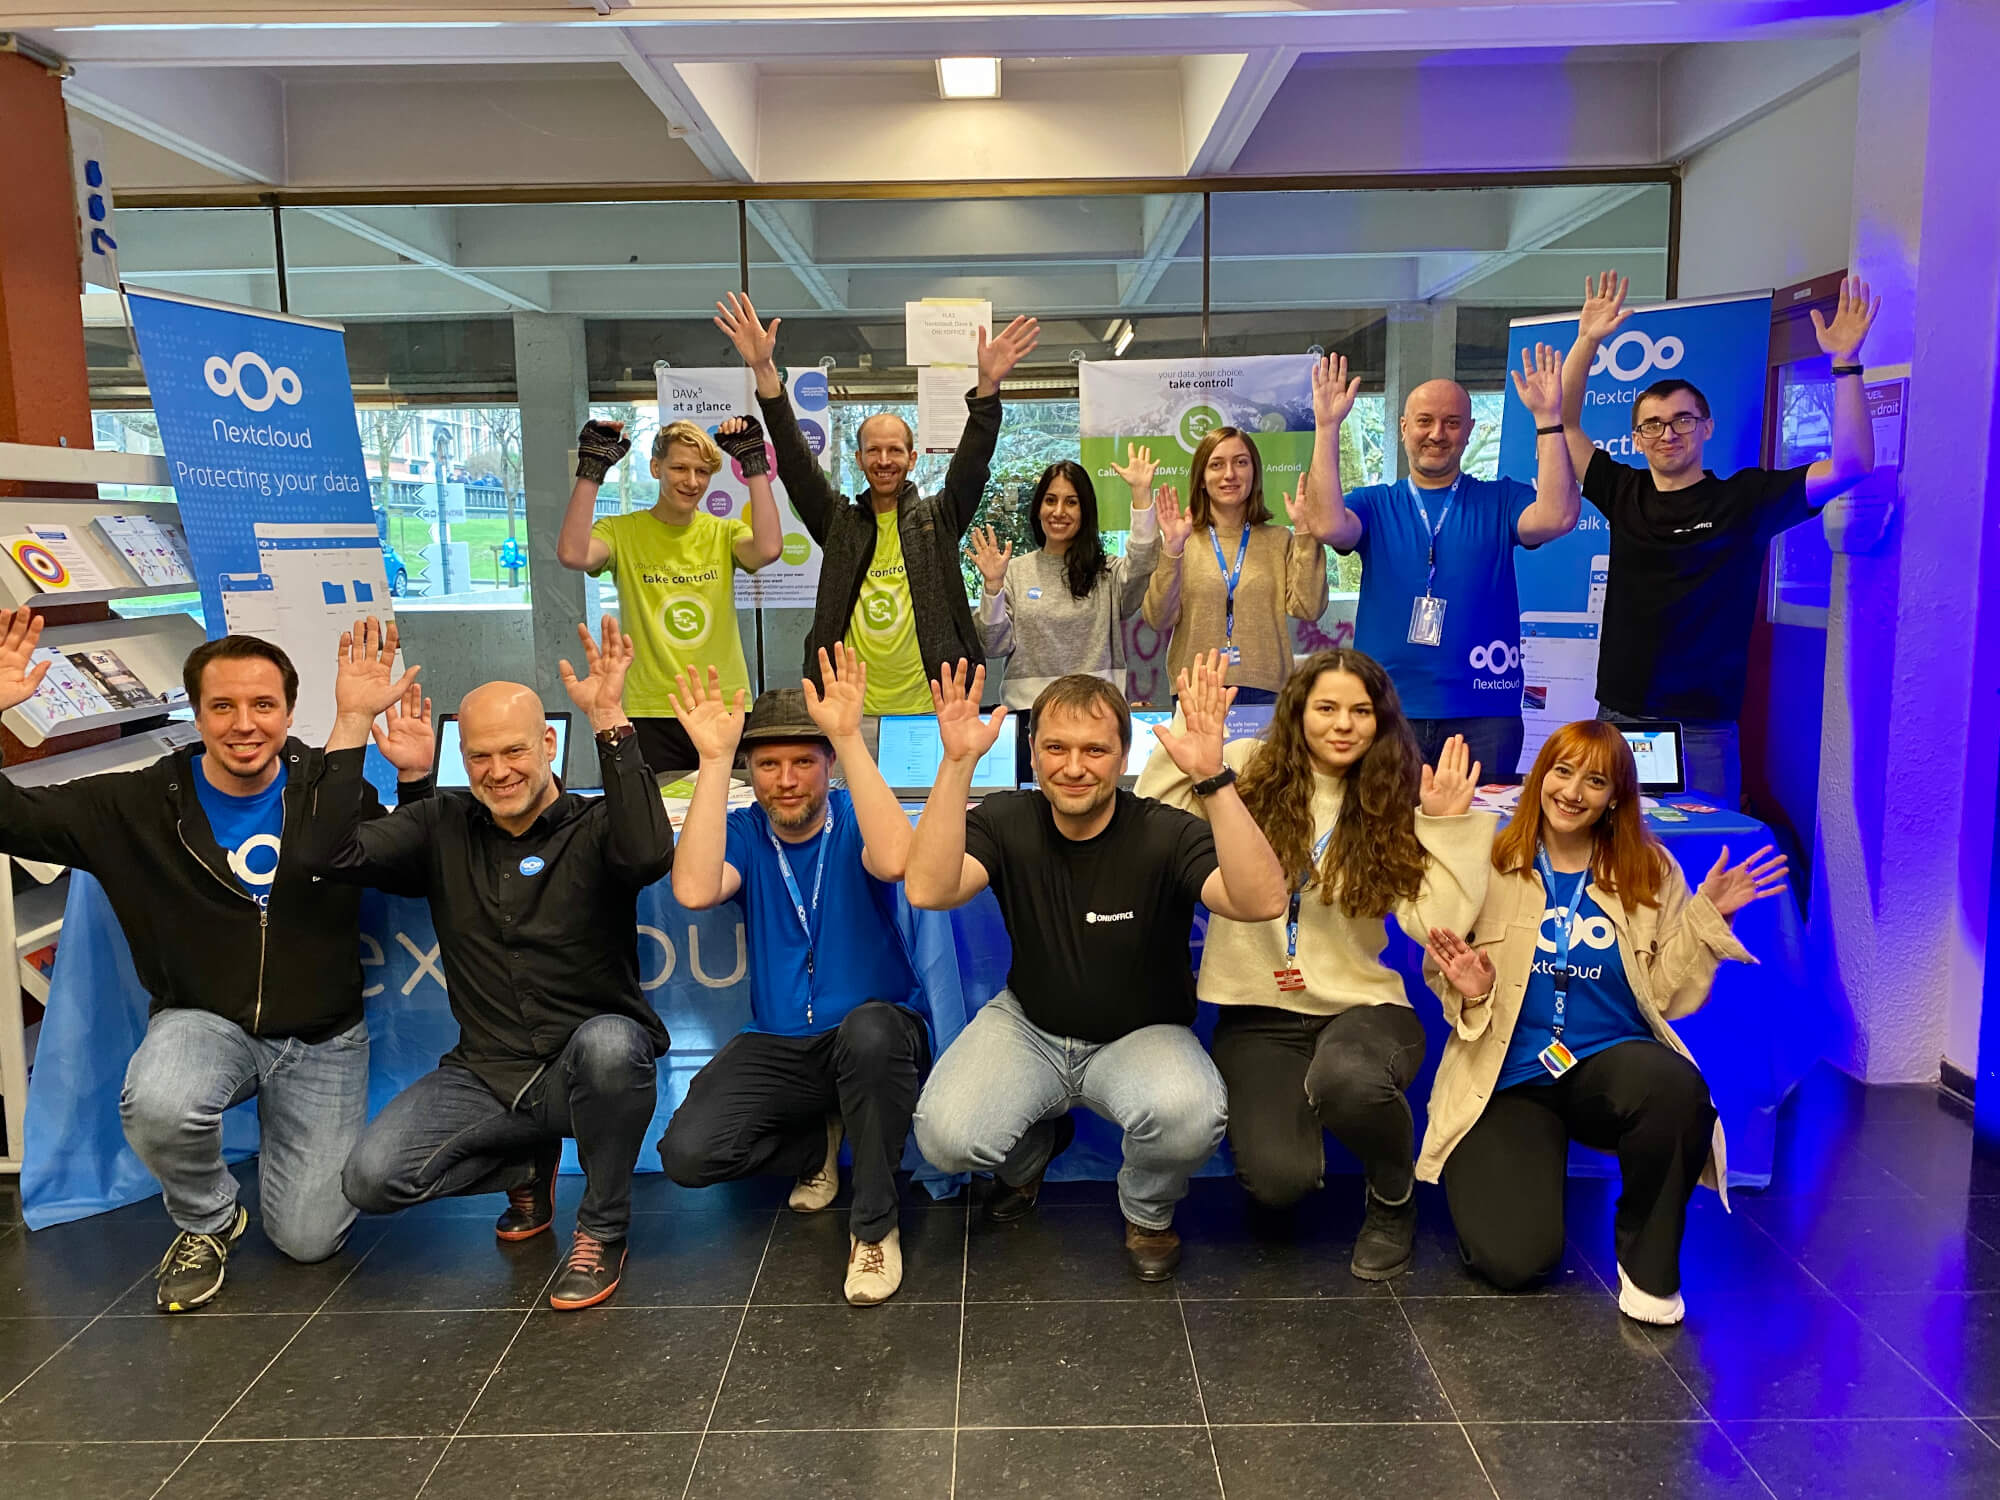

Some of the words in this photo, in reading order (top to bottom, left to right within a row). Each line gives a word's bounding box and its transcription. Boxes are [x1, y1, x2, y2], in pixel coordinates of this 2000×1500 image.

[1169, 380, 1191, 389] take
[1193, 378, 1233, 388] control!
[1585, 387, 1645, 406] Nextcl
[673, 402, 684, 411] at
[696, 401, 732, 413] glance
[1877, 401, 1899, 416] droit
[212, 418, 312, 449] Nextcloud
[1266, 463, 1302, 472] Android
[176, 461, 272, 497] Protecting
[273, 469, 317, 497] your
[323, 470, 360, 493] data
[1578, 516, 1600, 530] alk
[642, 574, 669, 584] take
[672, 570, 718, 584] control!
[870, 566, 904, 577] contro
[1473, 678, 1520, 689] Nextcloud
[1531, 960, 1602, 980] xtcoud
